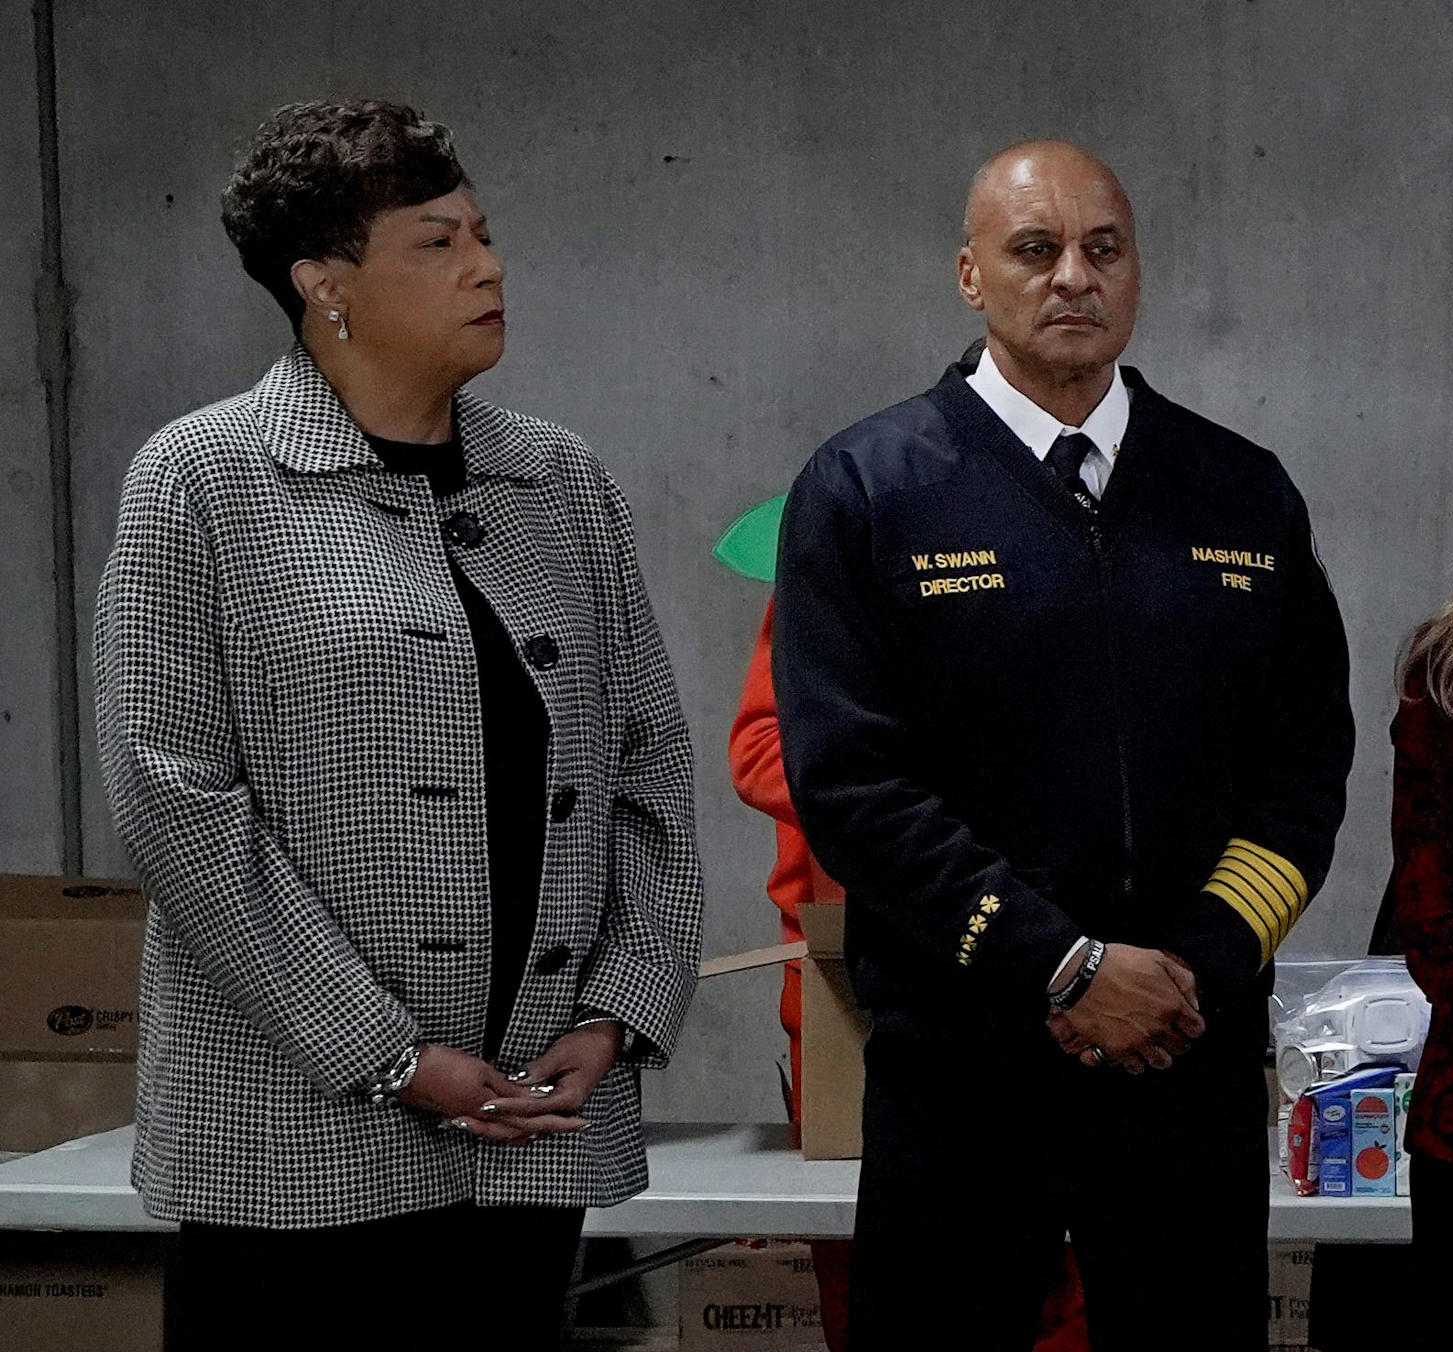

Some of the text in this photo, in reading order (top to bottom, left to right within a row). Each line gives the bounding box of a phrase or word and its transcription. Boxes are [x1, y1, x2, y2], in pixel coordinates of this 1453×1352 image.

[911, 549, 997, 571] W. SWANN
[1191, 546, 1275, 571] NASHVILLE
[919, 572, 1005, 597] DIRECTOR
[1222, 572, 1253, 592] FIRE
[96, 1010, 134, 1023] CRISPY
